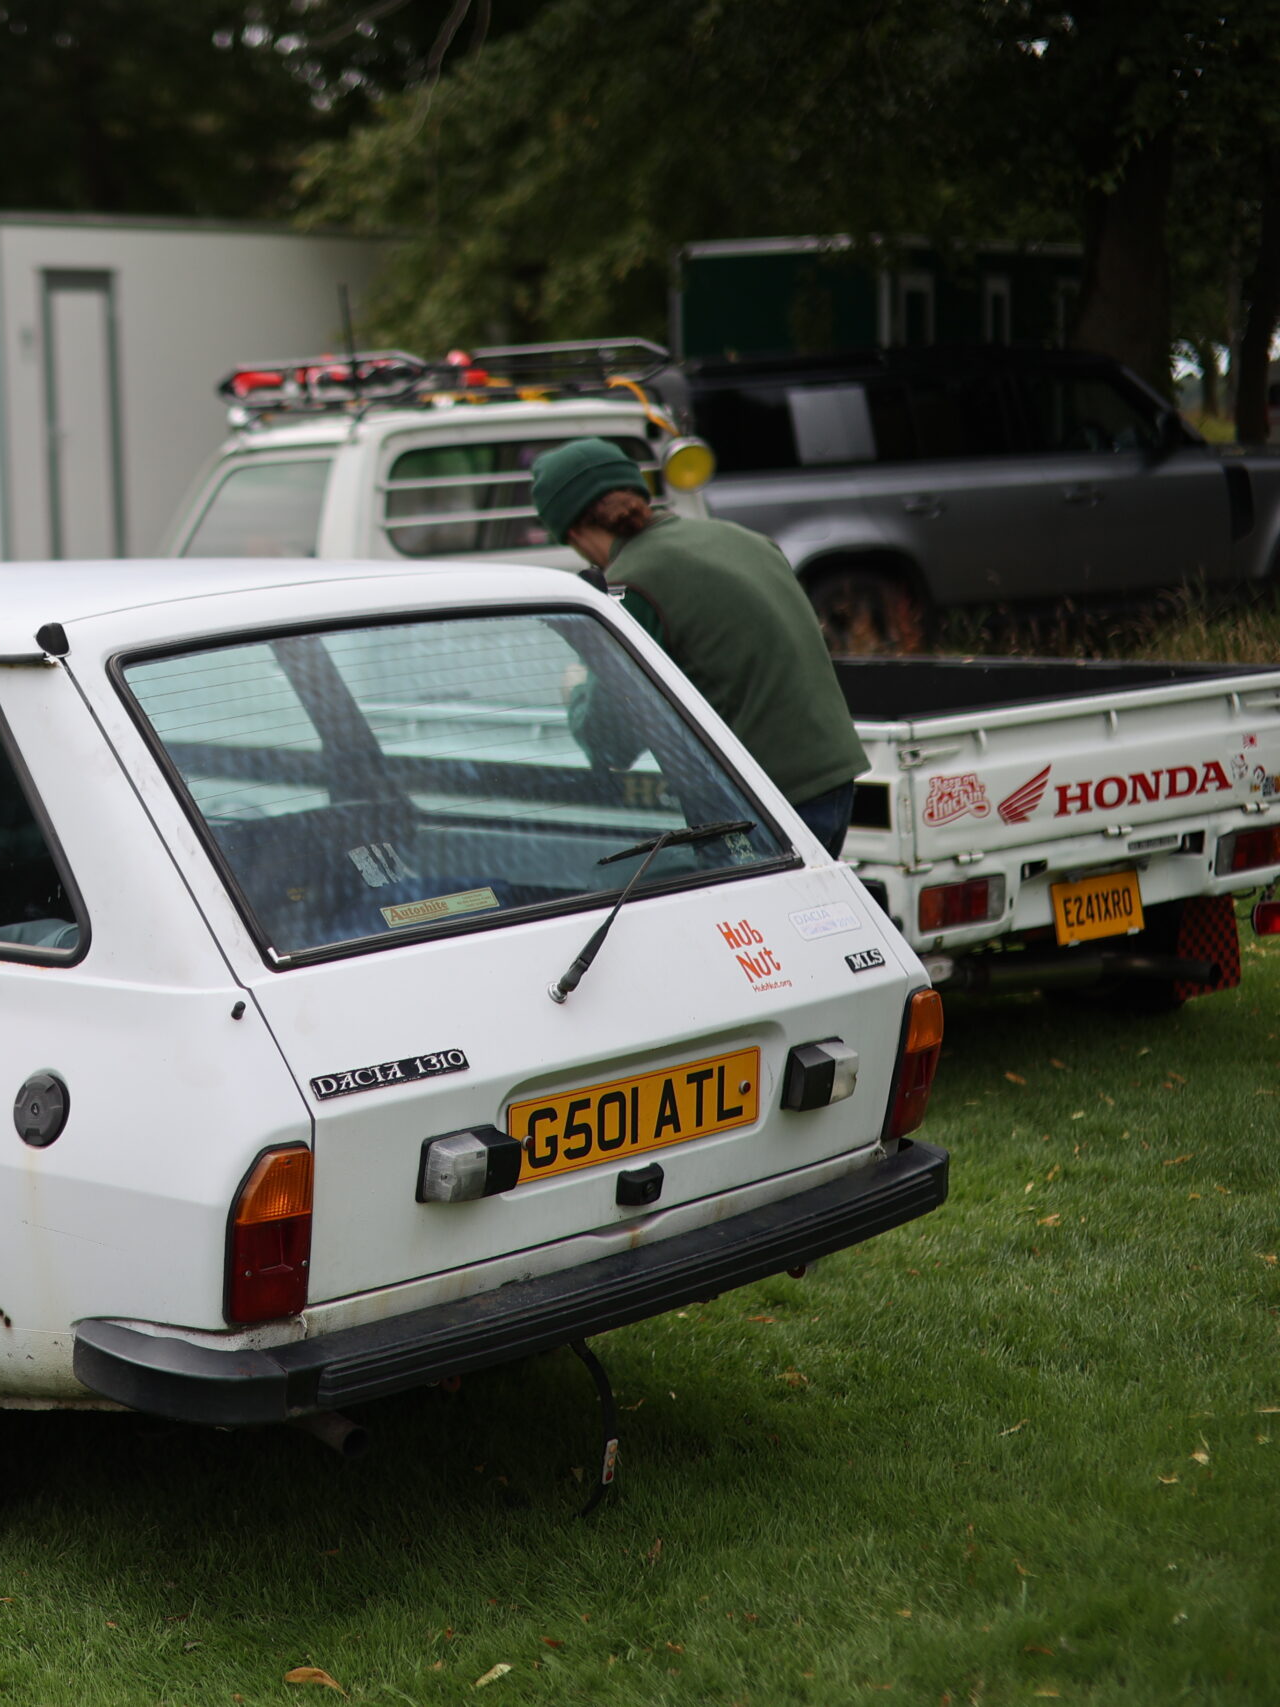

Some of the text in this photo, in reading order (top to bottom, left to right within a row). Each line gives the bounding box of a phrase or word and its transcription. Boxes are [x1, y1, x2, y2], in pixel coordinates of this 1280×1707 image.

[1055, 761, 1232, 817] HONDA
[391, 900, 448, 921] Autoshite
[795, 909, 830, 925] DACIA
[1063, 887, 1133, 927] E241XRO
[851, 949, 884, 970] MLS
[318, 1050, 464, 1096] DACIA 1310
[526, 1065, 744, 1169] G501 ATL
